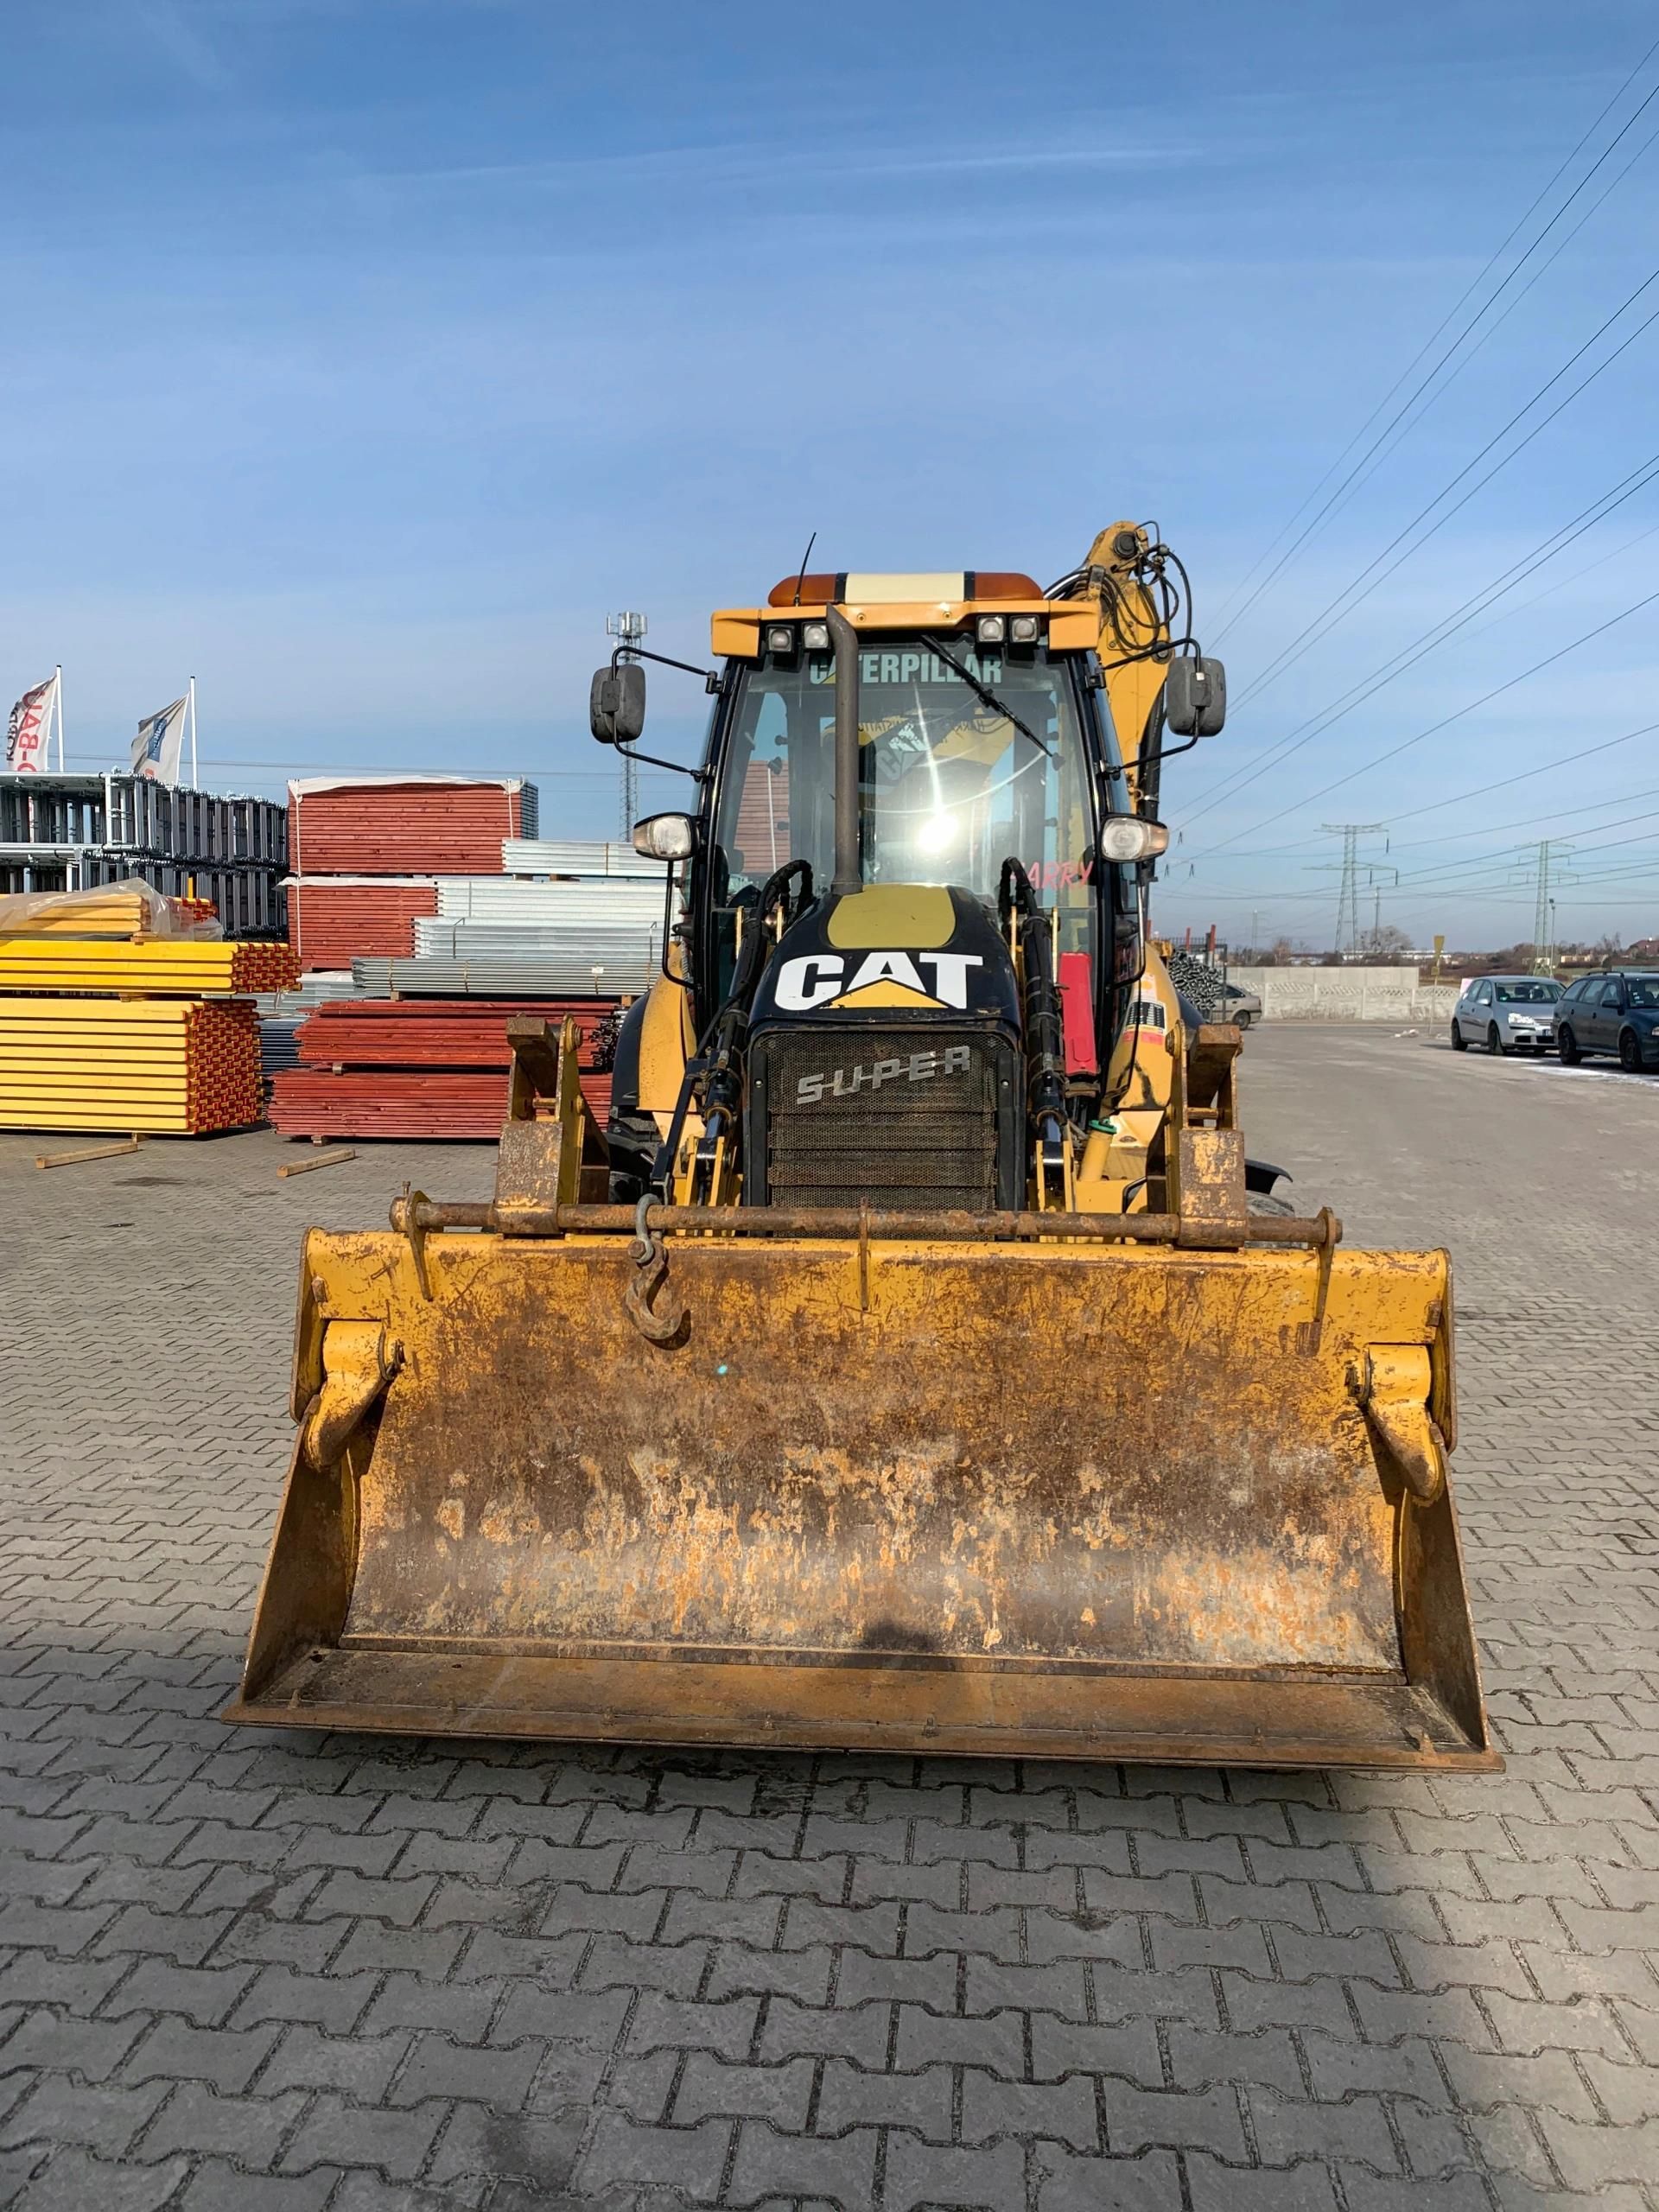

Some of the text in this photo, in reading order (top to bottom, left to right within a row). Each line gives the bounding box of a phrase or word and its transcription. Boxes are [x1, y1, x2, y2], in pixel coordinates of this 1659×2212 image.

[810, 653, 1001, 684] CERPILLAR
[1010, 861, 1094, 890] ARRY
[774, 951, 983, 1011] CAT
[797, 1046, 969, 1104] SUPER
